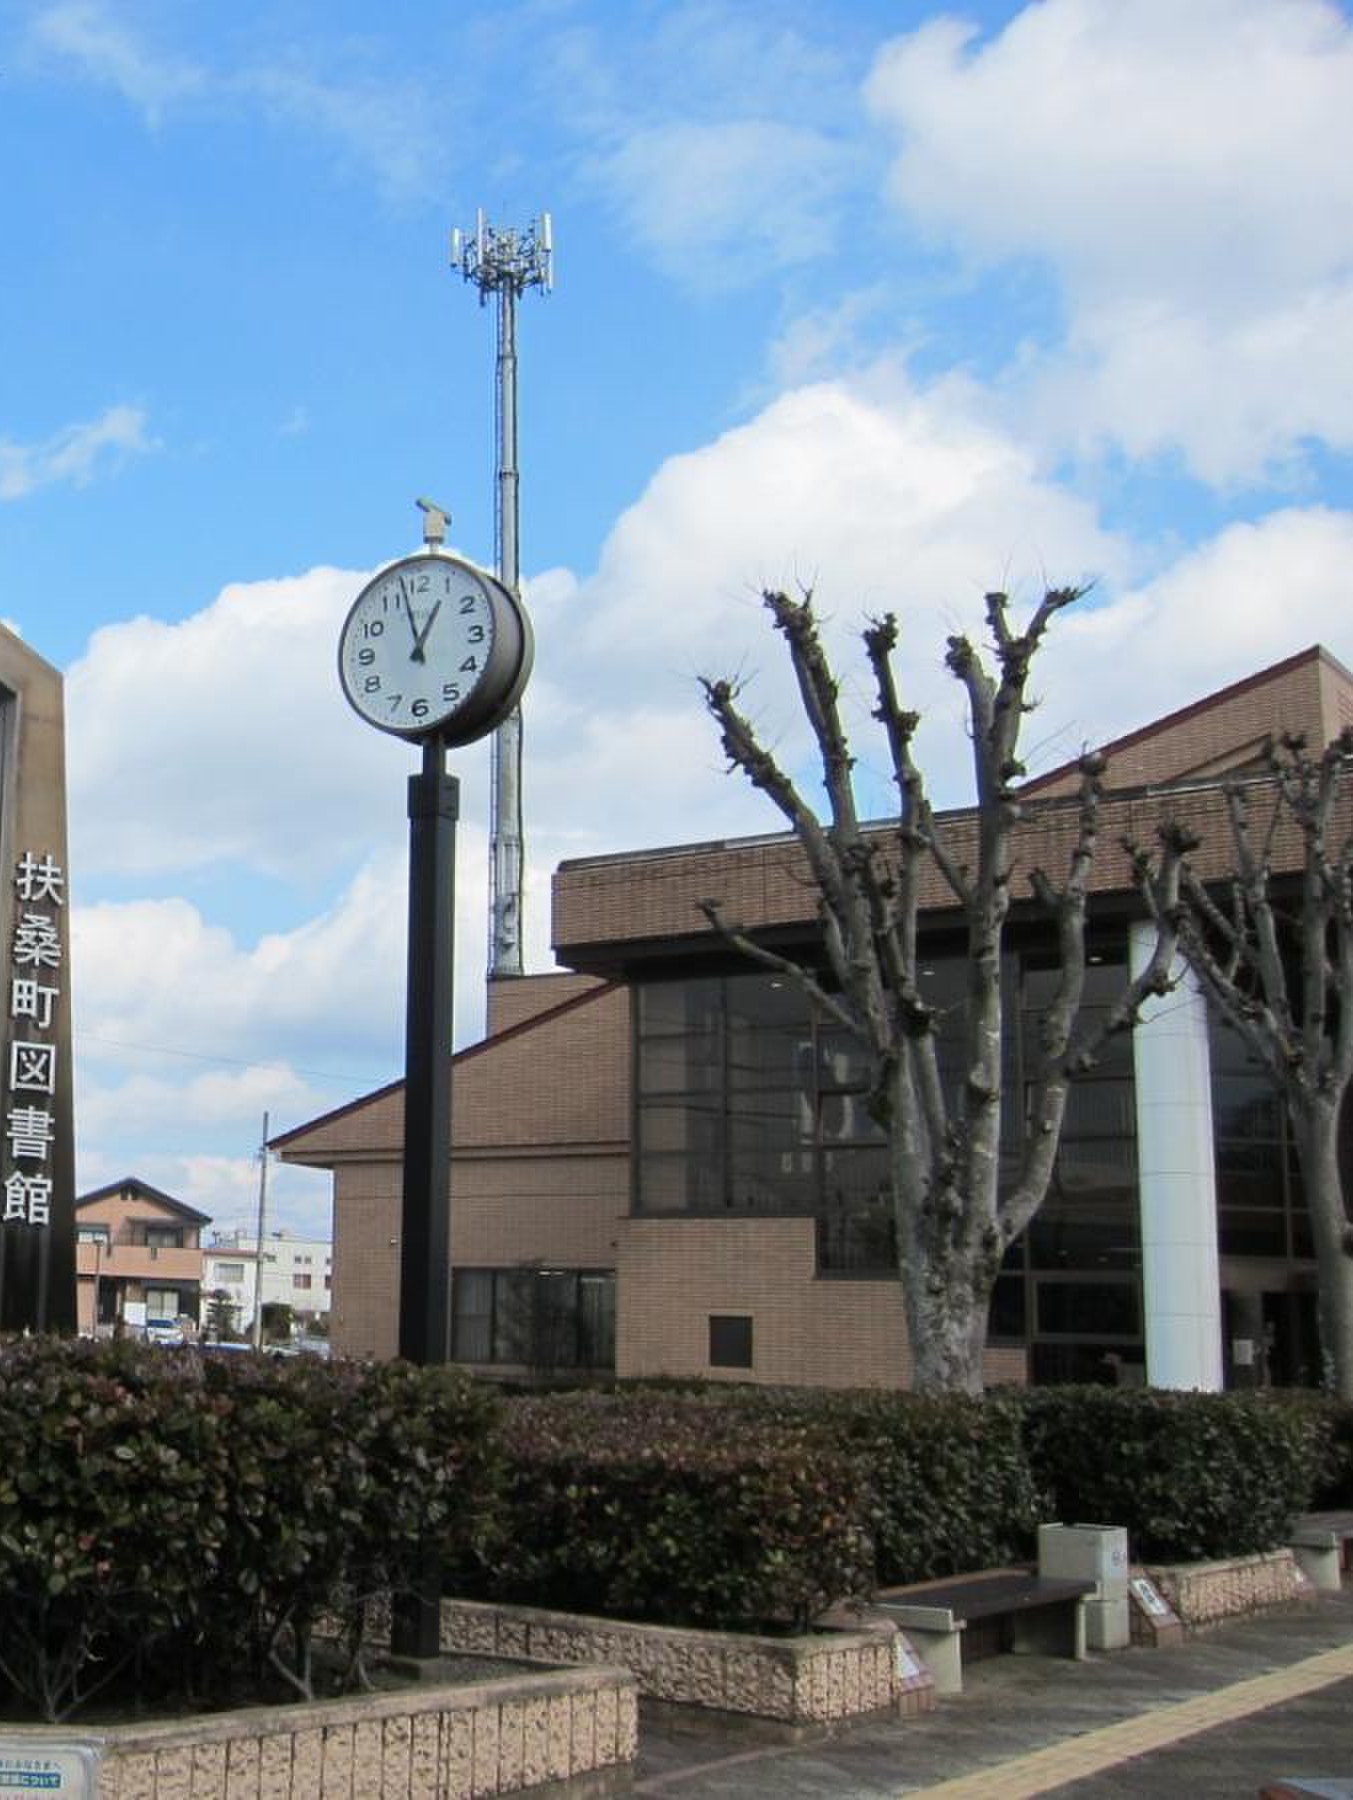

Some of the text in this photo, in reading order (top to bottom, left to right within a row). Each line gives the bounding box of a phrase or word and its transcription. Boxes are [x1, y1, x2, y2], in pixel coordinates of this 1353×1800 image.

[410, 575, 430, 595] 12
[445, 577, 451, 594] 1
[383, 594, 400, 612] 11
[460, 595, 476, 614] 2
[363, 620, 385, 639] 10
[468, 625, 485, 644] 3
[358, 648, 376, 666] 9
[459, 655, 478, 673] 4
[364, 675, 381, 693] 8
[442, 682, 460, 701] 5
[387, 694, 403, 712] 7
[411, 698, 430, 717] 6
[2, 851, 65, 1225] 扶桑町図書館
